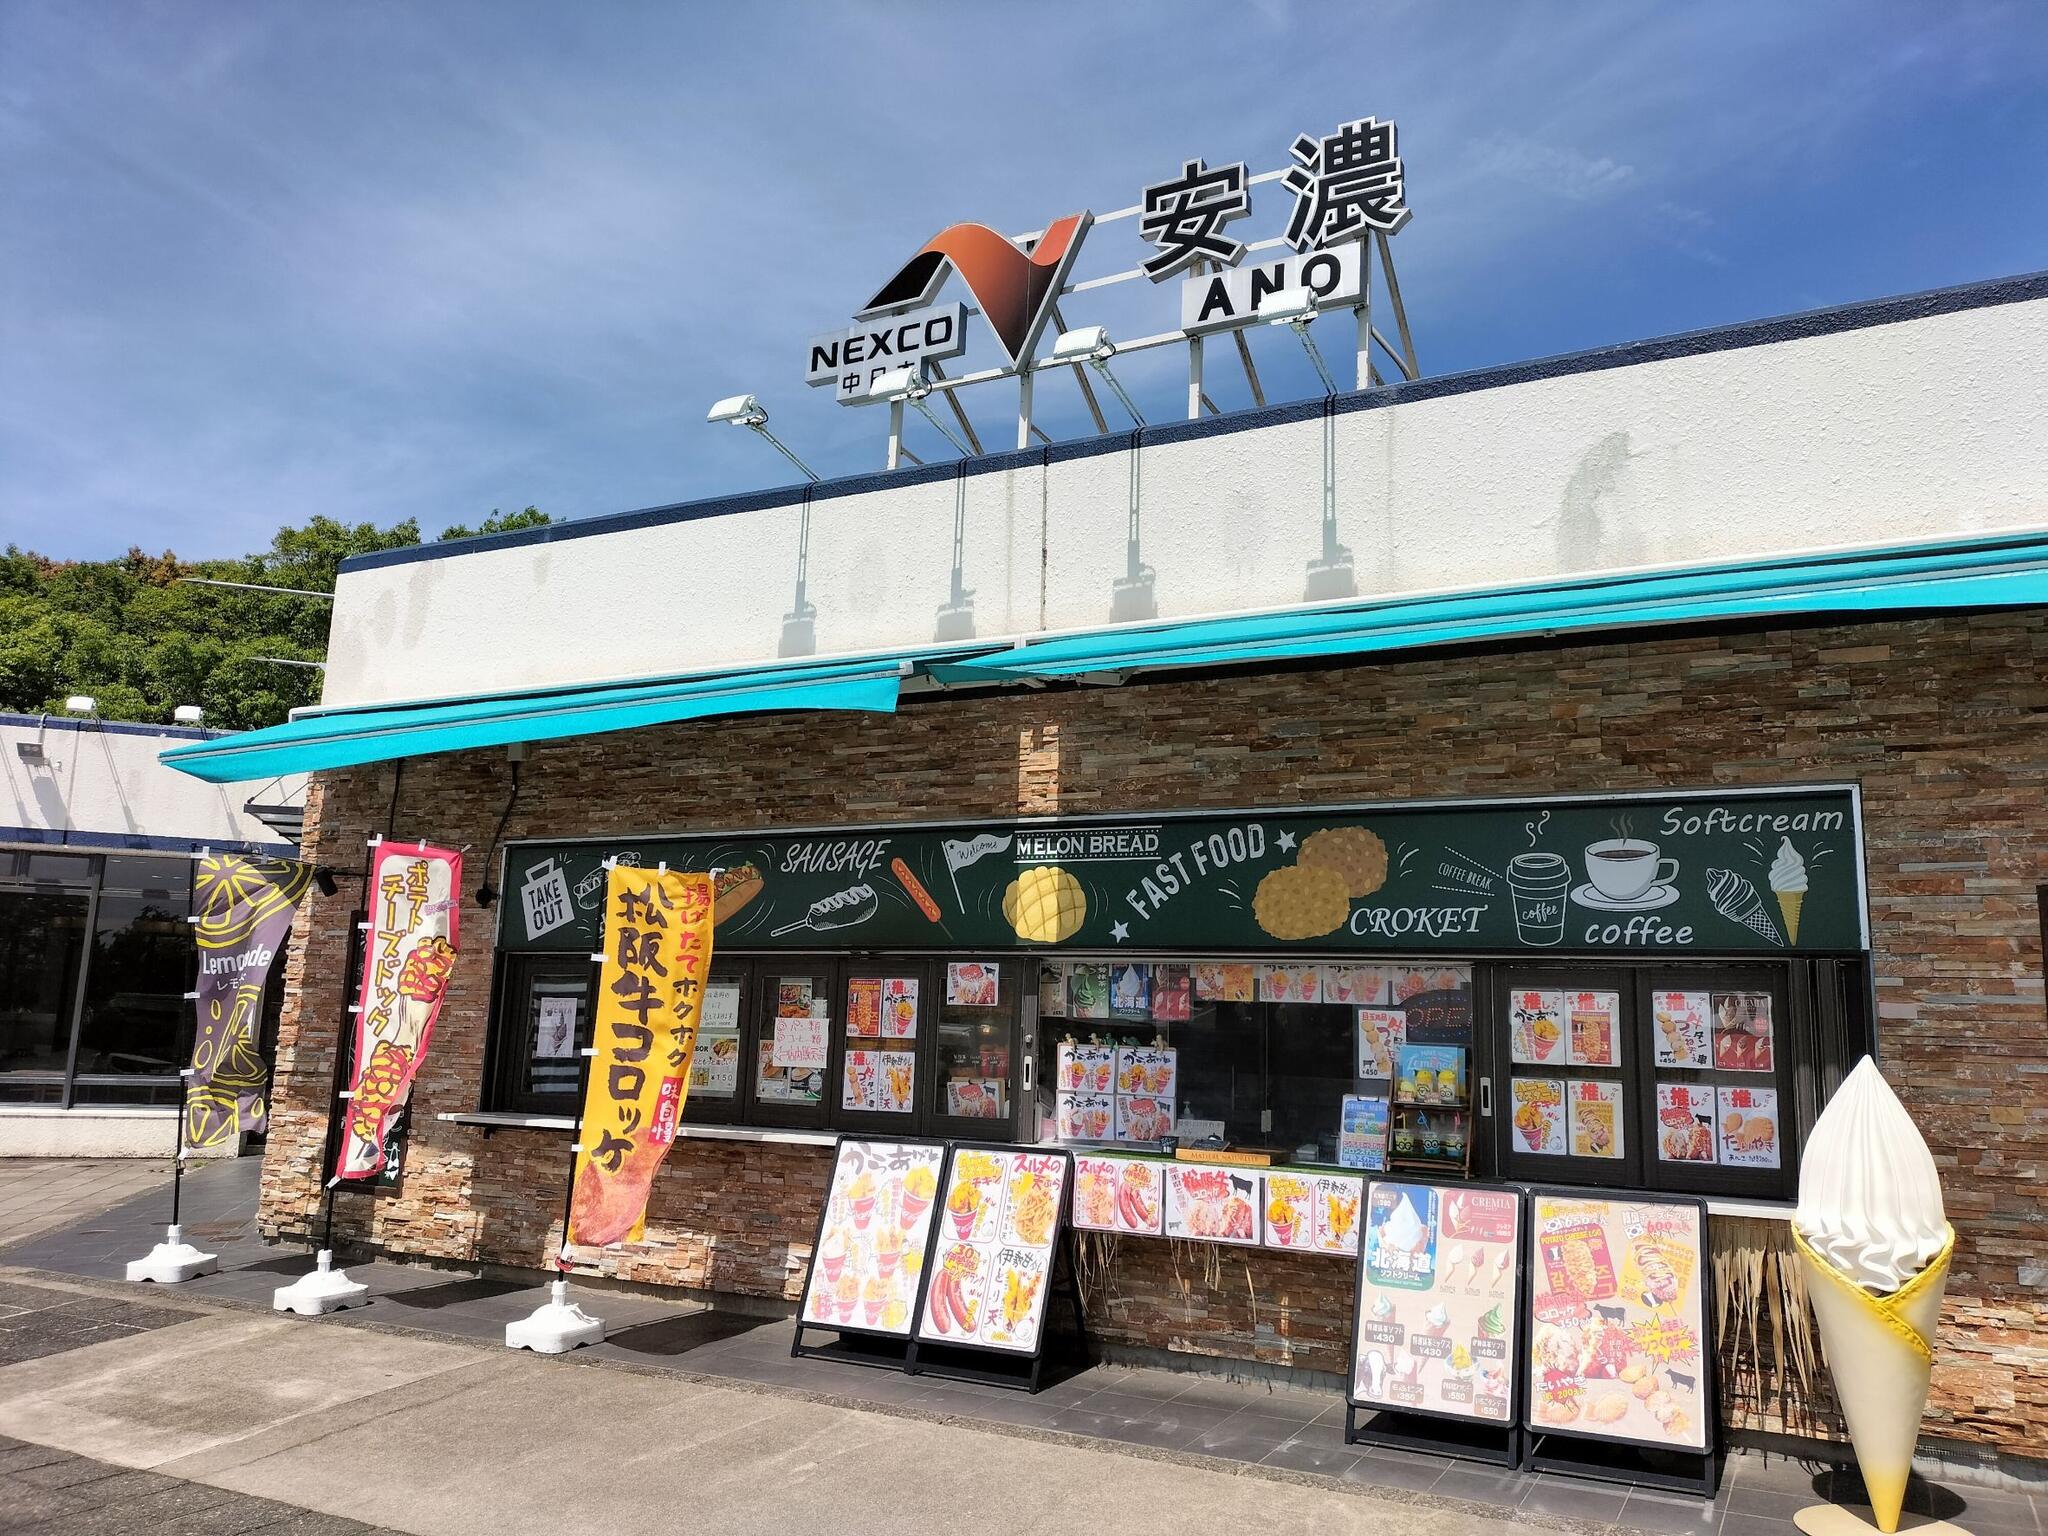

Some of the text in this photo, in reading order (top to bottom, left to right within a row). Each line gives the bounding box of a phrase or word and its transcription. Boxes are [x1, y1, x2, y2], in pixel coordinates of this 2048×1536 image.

[1139, 115, 1413, 283] 安濃
[1198, 252, 1342, 322] ANO
[811, 315, 953, 373] NEXCO
[1659, 806, 1844, 837] Softcream
[780, 838, 893, 875] SAUSAGE
[956, 841, 1000, 862] Welcome
[1016, 833, 1160, 857] MELON BREAD
[1125, 823, 1267, 921] FAST FOOD
[1437, 862, 1494, 891] COFFEE BREAK
[406, 860, 430, 934] ポテト
[527, 880, 562, 907] TAKE
[532, 902, 567, 931] OUT
[1349, 904, 1489, 938] CROKET
[1521, 901, 1560, 922] coffee
[676, 883, 711, 974] 揚げたて
[1584, 915, 1694, 945] coffee
[366, 874, 407, 1037] チーズドッグ
[591, 882, 674, 1172] 松阪牛コロッケ
[667, 976, 698, 1068] ホクホク
[1406, 1007, 1473, 1028] OPE
[651, 1083, 680, 1144] 味自慢
[1014, 1154, 1061, 1174] スルメの
[1078, 1160, 1114, 1175] スルメの
[1472, 1196, 1512, 1210] CREMIA
[1371, 1248, 1432, 1274] 北海道
[1380, 1269, 1421, 1282] ソフトクリーム
[1536, 1374, 1588, 1393] たいやき
